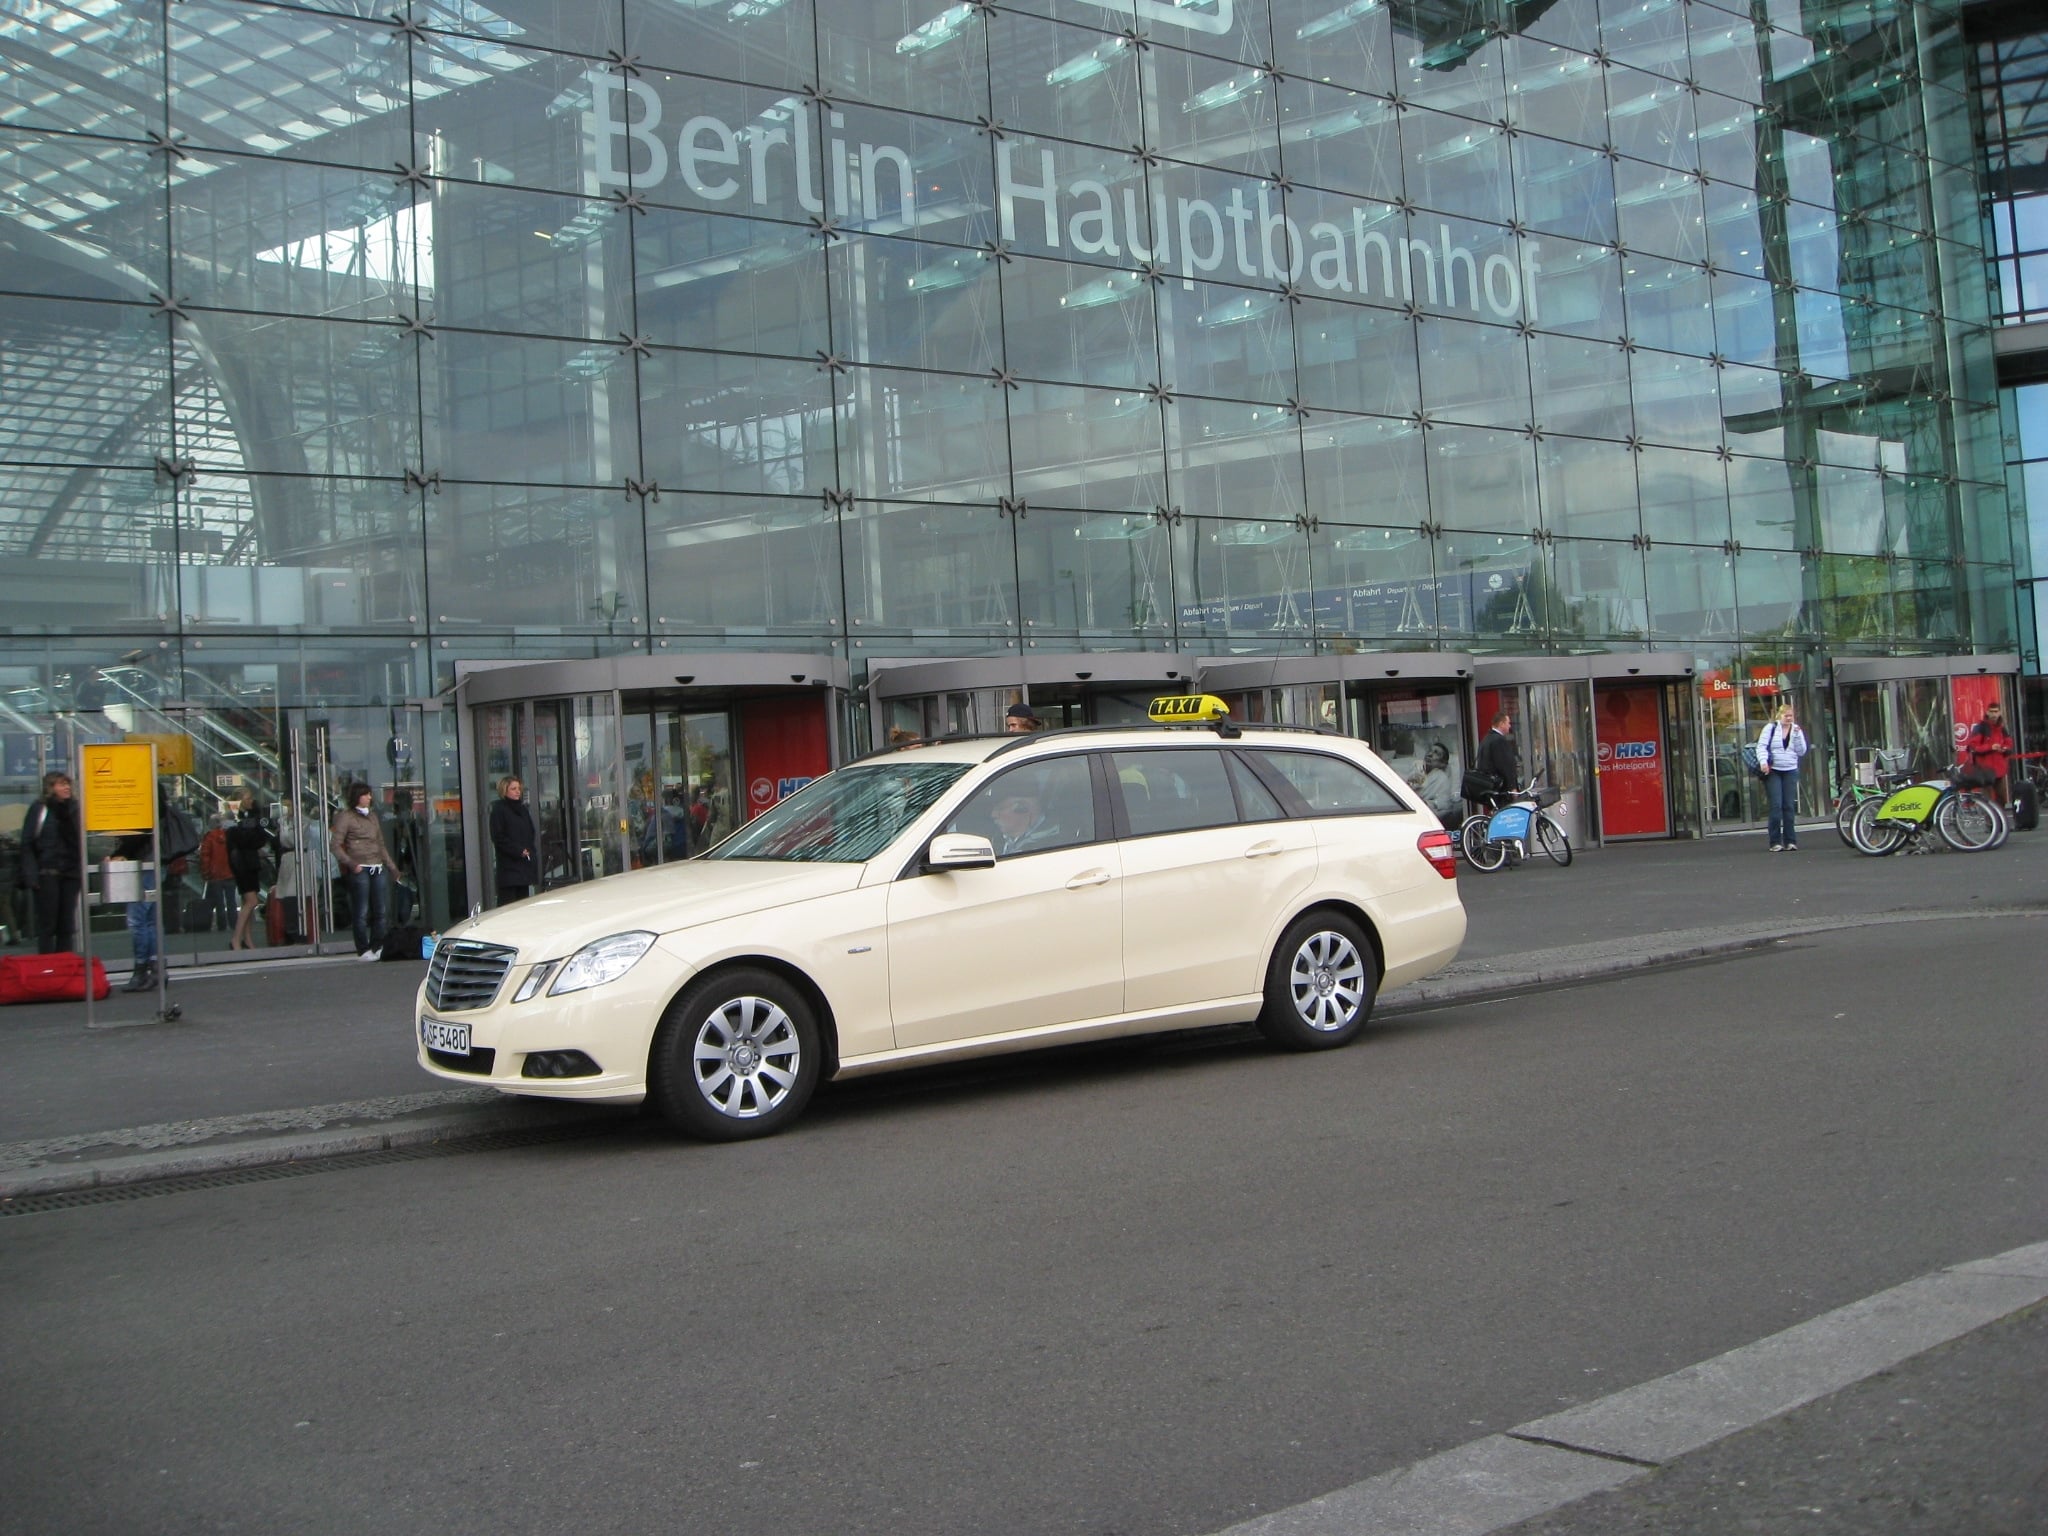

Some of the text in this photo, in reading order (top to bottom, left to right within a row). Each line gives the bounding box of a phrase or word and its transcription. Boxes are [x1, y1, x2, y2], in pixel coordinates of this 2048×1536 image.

[590, 70, 1542, 322] Berlin Hauptbahnhof
[1353, 588, 1381, 598] Abfahrt
[1183, 607, 1210, 617] Abfahrt
[1157, 698, 1196, 714] TAXI
[1615, 741, 1656, 759] HRS
[1612, 760, 1656, 770] Hotelportal
[1890, 802, 1922, 812] airBaltic
[439, 1026, 467, 1050] 5480
